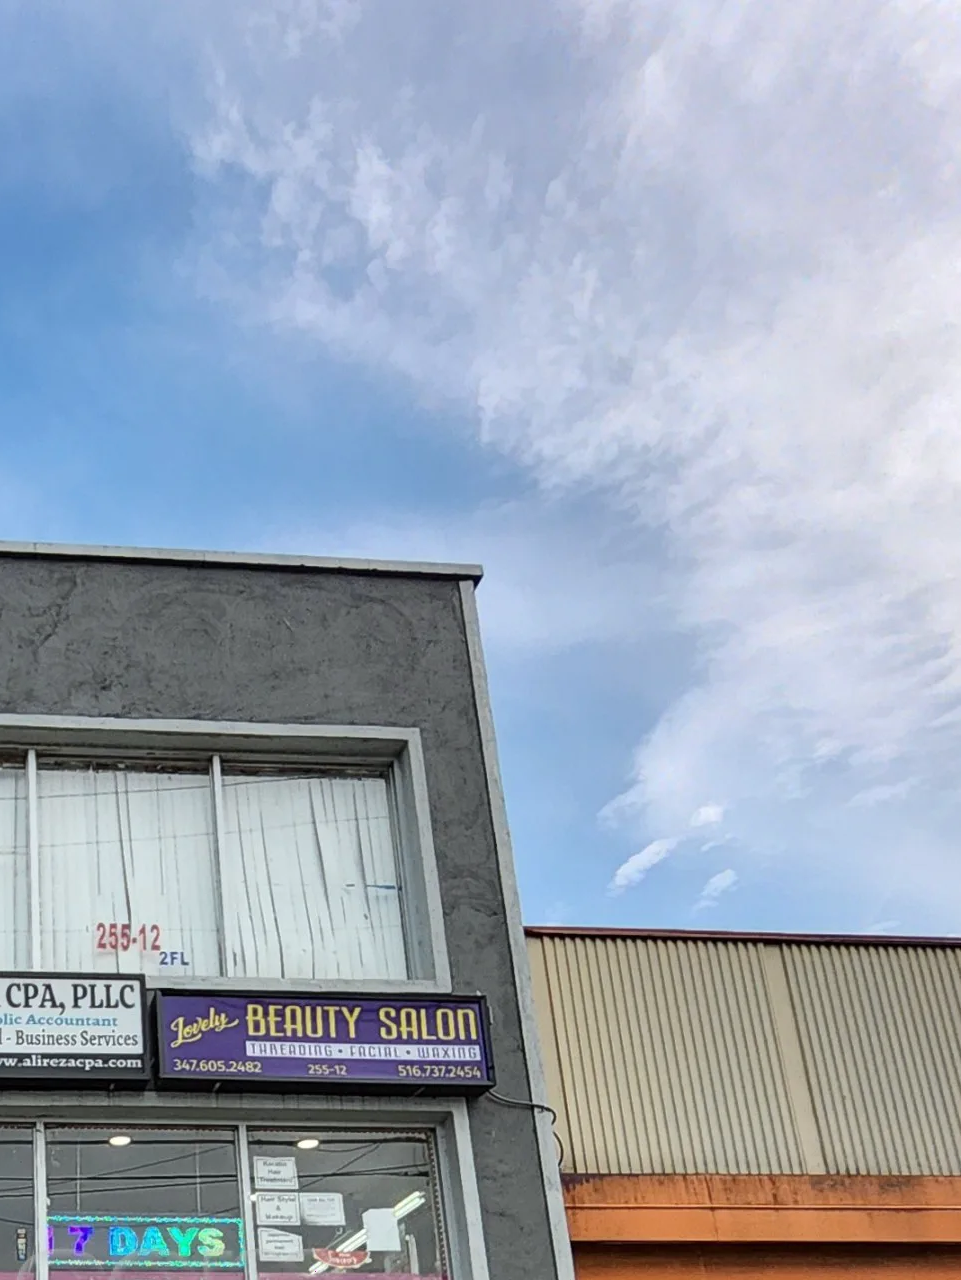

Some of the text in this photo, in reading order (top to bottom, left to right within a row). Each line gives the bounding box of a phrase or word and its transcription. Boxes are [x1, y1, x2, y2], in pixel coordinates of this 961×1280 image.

[96, 922, 161, 951] 255-12
[159, 951, 189, 966] 2FL
[5, 983, 66, 1015] CPA,
[71, 984, 135, 1009] PLLC
[25, 1014, 118, 1027] Accountant
[170, 1004, 478, 1048] Lovely BEAUTY SALON
[15, 1029, 77, 1046] Business
[80, 1030, 138, 1047] Services
[250, 1042, 477, 1059] THREADING FACIAL WAXING
[173, 1058, 262, 1073] 347.605.2482
[307, 1064, 347, 1076] 255-12
[397, 1065, 481, 1078] 516.737.2454
[67, 1226, 94, 1257] 7
[109, 1226, 226, 1257] DAYS
